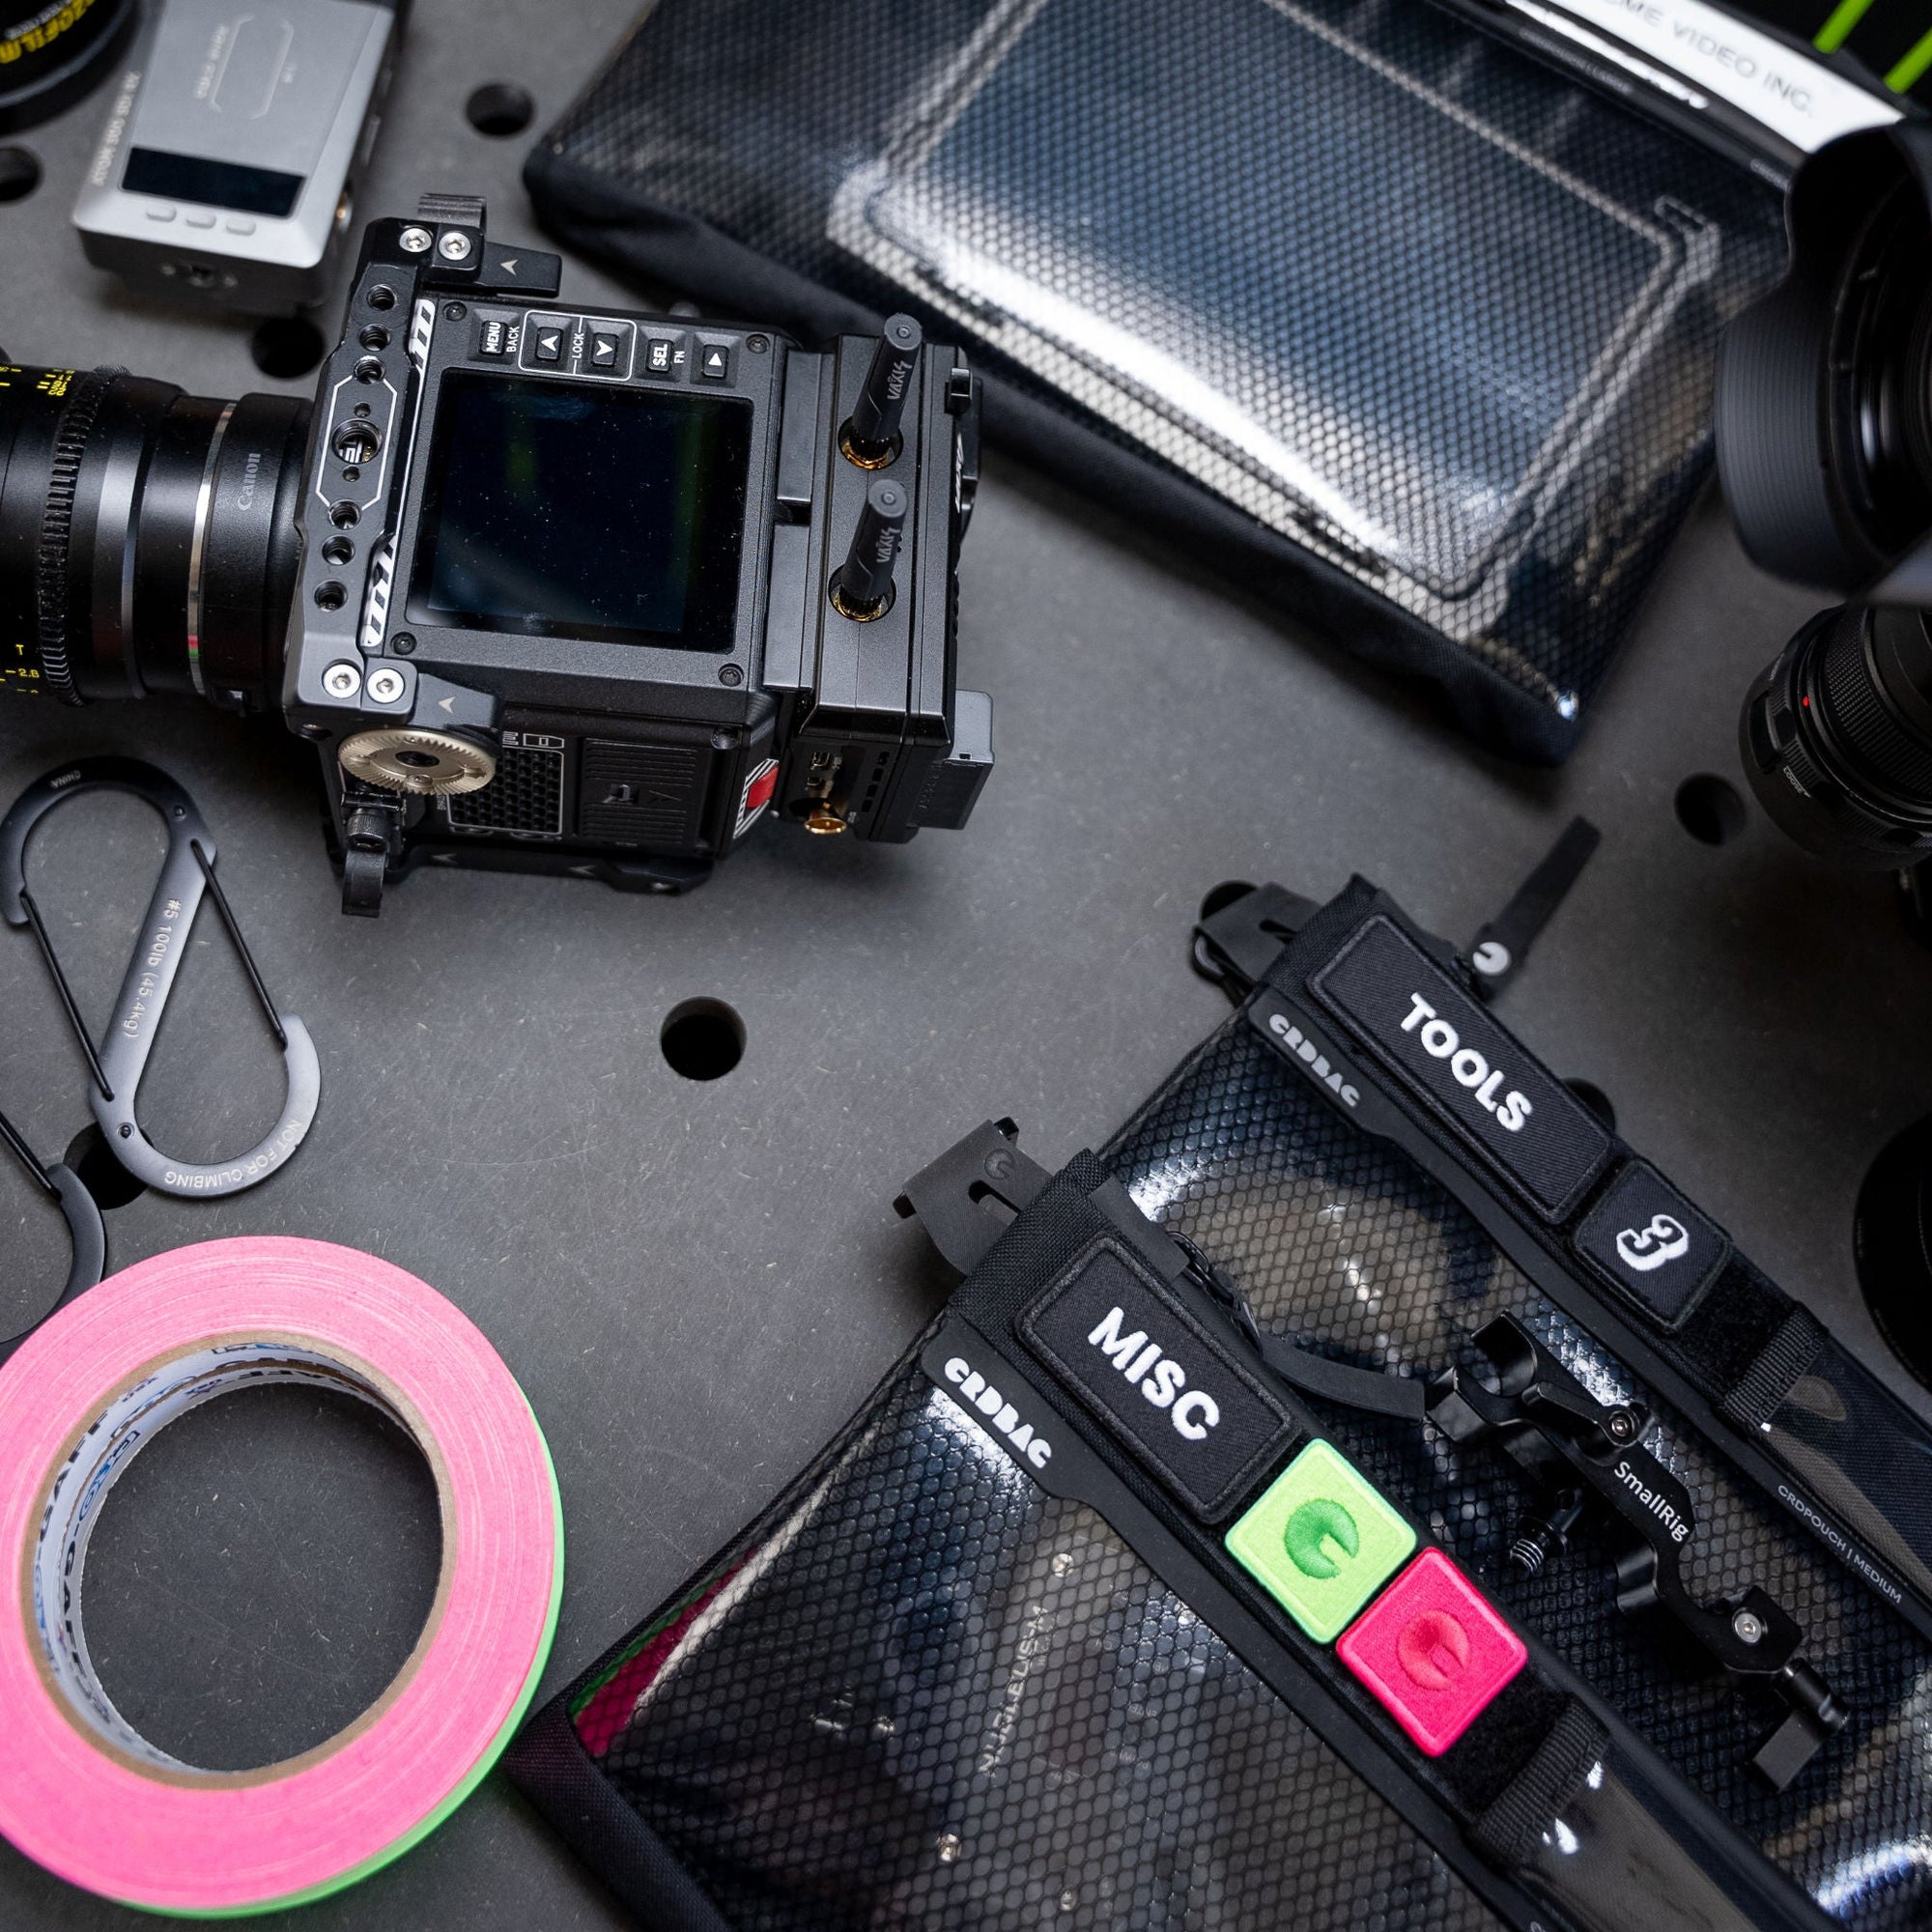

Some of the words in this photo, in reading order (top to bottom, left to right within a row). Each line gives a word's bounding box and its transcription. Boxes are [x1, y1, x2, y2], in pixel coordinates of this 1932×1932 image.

[1672, 11, 1757, 78] VIDEO
[486, 321, 501, 353] MENU
[506, 326, 520, 354] BACK
[573, 332, 585, 359] LOCK
[652, 344, 668, 366] SEL
[674, 350, 685, 364] FN
[237, 451, 262, 511] Canon
[18, 668, 40, 678] 2.8
[50, 769, 81, 791] CHINA
[165, 898, 181, 921] #5
[147, 923, 173, 968] 100lb
[122, 969, 156, 1039] (45.4kg)
[1399, 991, 1534, 1133] TOOLS
[275, 1119, 302, 1151] NOT
[245, 1147, 277, 1175] FOR
[163, 1168, 242, 1189] CLIMBING
[1614, 1212, 1690, 1272] 3
[1086, 1305, 1221, 1441] MISC
[1613, 1461, 1690, 1544] SmallRig
[1776, 1484, 1848, 1552] CRDPOUCH
[1853, 1553, 1903, 1605] MEDIUM
